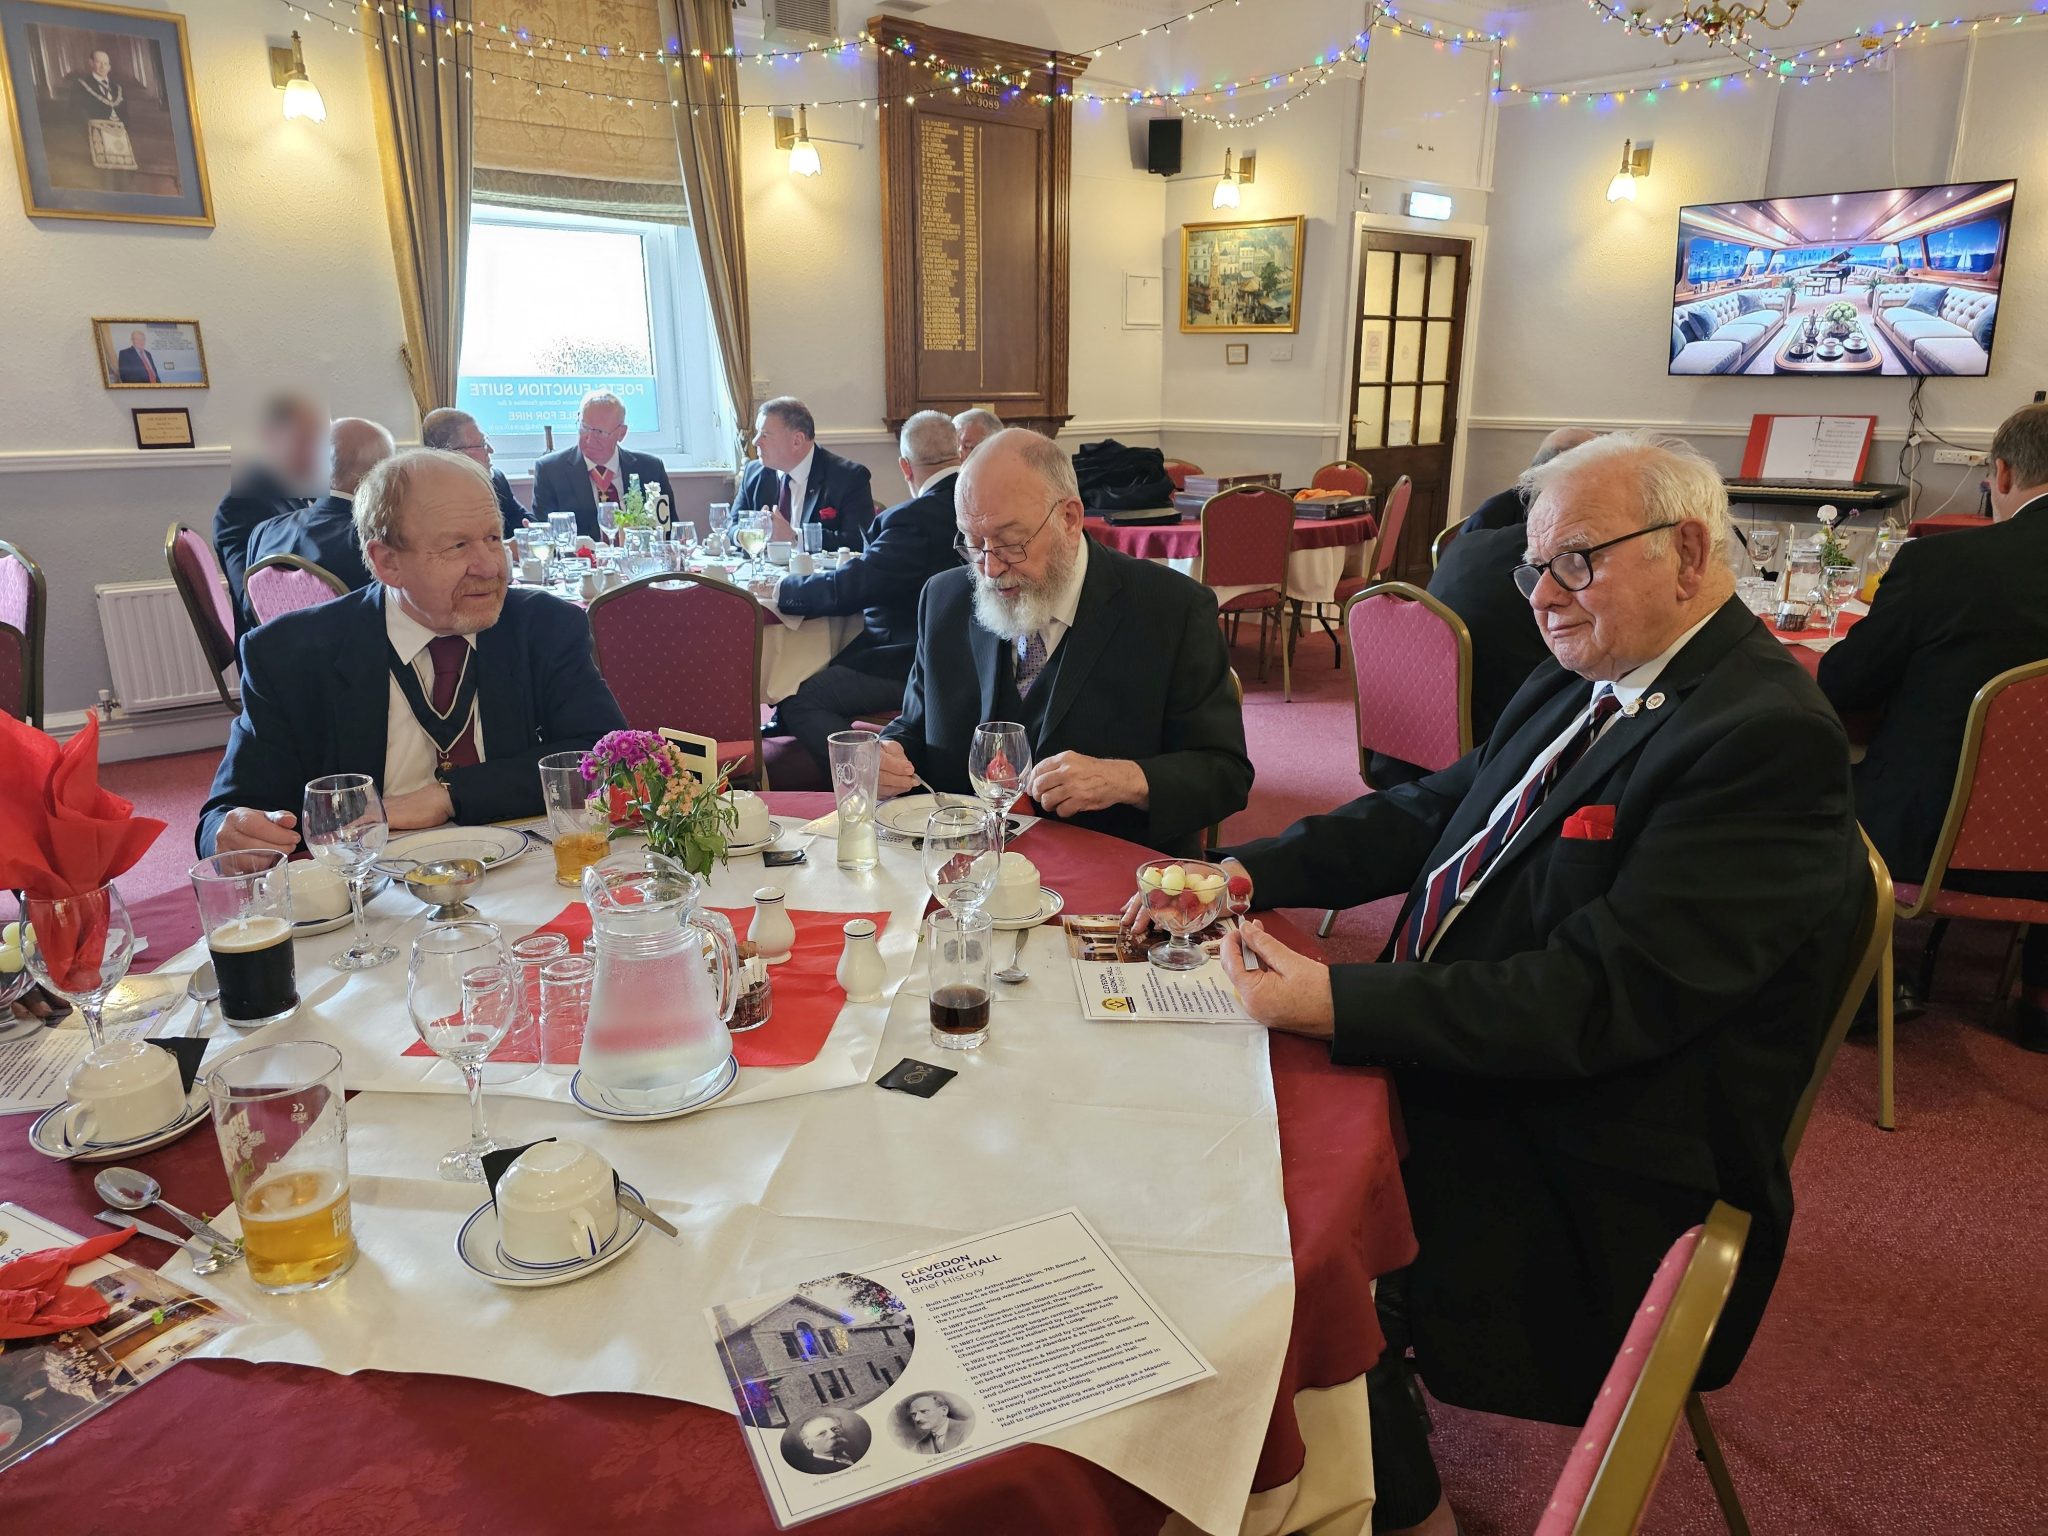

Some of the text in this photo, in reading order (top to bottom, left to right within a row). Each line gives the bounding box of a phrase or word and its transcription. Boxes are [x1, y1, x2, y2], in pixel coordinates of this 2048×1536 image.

[966, 84, 1000, 96] LODGE
[978, 98, 1000, 110] 9089
[656, 499, 669, 524] C
[902, 1254, 970, 1279] CLEVEDON
[906, 1254, 1002, 1286] MASONIC HALL
[984, 1282, 1003, 1290] Arthur
[1055, 1259, 1079, 1268] Baronet
[911, 1268, 985, 1294] Brief History
[1016, 1283, 1044, 1294] extended
[1053, 1268, 1095, 1282] accommodate
[929, 1301, 959, 1311] Clevedon
[944, 1326, 967, 1335] formed
[977, 1317, 1000, 1325] replace
[1068, 1288, 1092, 1297] vacated
[948, 1312, 965, 1320] Local
[964, 1316, 983, 1324] when
[983, 1307, 1013, 1318] Clevedon
[1034, 1293, 1057, 1302] District
[1058, 1286, 1081, 1295] Council
[975, 1330, 1006, 1341] Coleridge
[1007, 1323, 1027, 1331] Lodge
[1050, 1309, 1073, 1318] renting
[995, 1316, 1017, 1326] moved
[965, 1339, 996, 1350] meetings
[1025, 1320, 1053, 1331] followed
[998, 1347, 1019, 1355] Public
[1072, 1321, 1101, 1331] Clevedon
[1071, 1334, 1104, 1348] purchased
[957, 1348, 984, 1358] Chapter
[966, 1363, 987, 1371] Estate
[1007, 1348, 1033, 1358] Thomas
[979, 1384, 1003, 1393] During
[1084, 1347, 1114, 1359] extended
[984, 1372, 1006, 1381] behalf
[996, 1393, 1023, 1405] January
[1068, 1370, 1095, 1380] Masonic
[1096, 1360, 1124, 1371] Meeting
[1138, 1349, 1153, 1357] held
[998, 1380, 1032, 1393] converted
[1066, 1360, 1096, 1371] Clevedon
[1097, 1350, 1124, 1361] Masonic
[1005, 1399, 1025, 1408] newly
[1027, 1387, 1061, 1401] converted
[1006, 1410, 1022, 1418] April
[1052, 1392, 1081, 1403] building
[1096, 1374, 1129, 1388] dedicated
[1143, 1361, 1170, 1371] Masonic
[1000, 1419, 1014, 1427] Hall
[1025, 1406, 1057, 1419] celebrate
[1071, 1390, 1104, 1403] centenary
